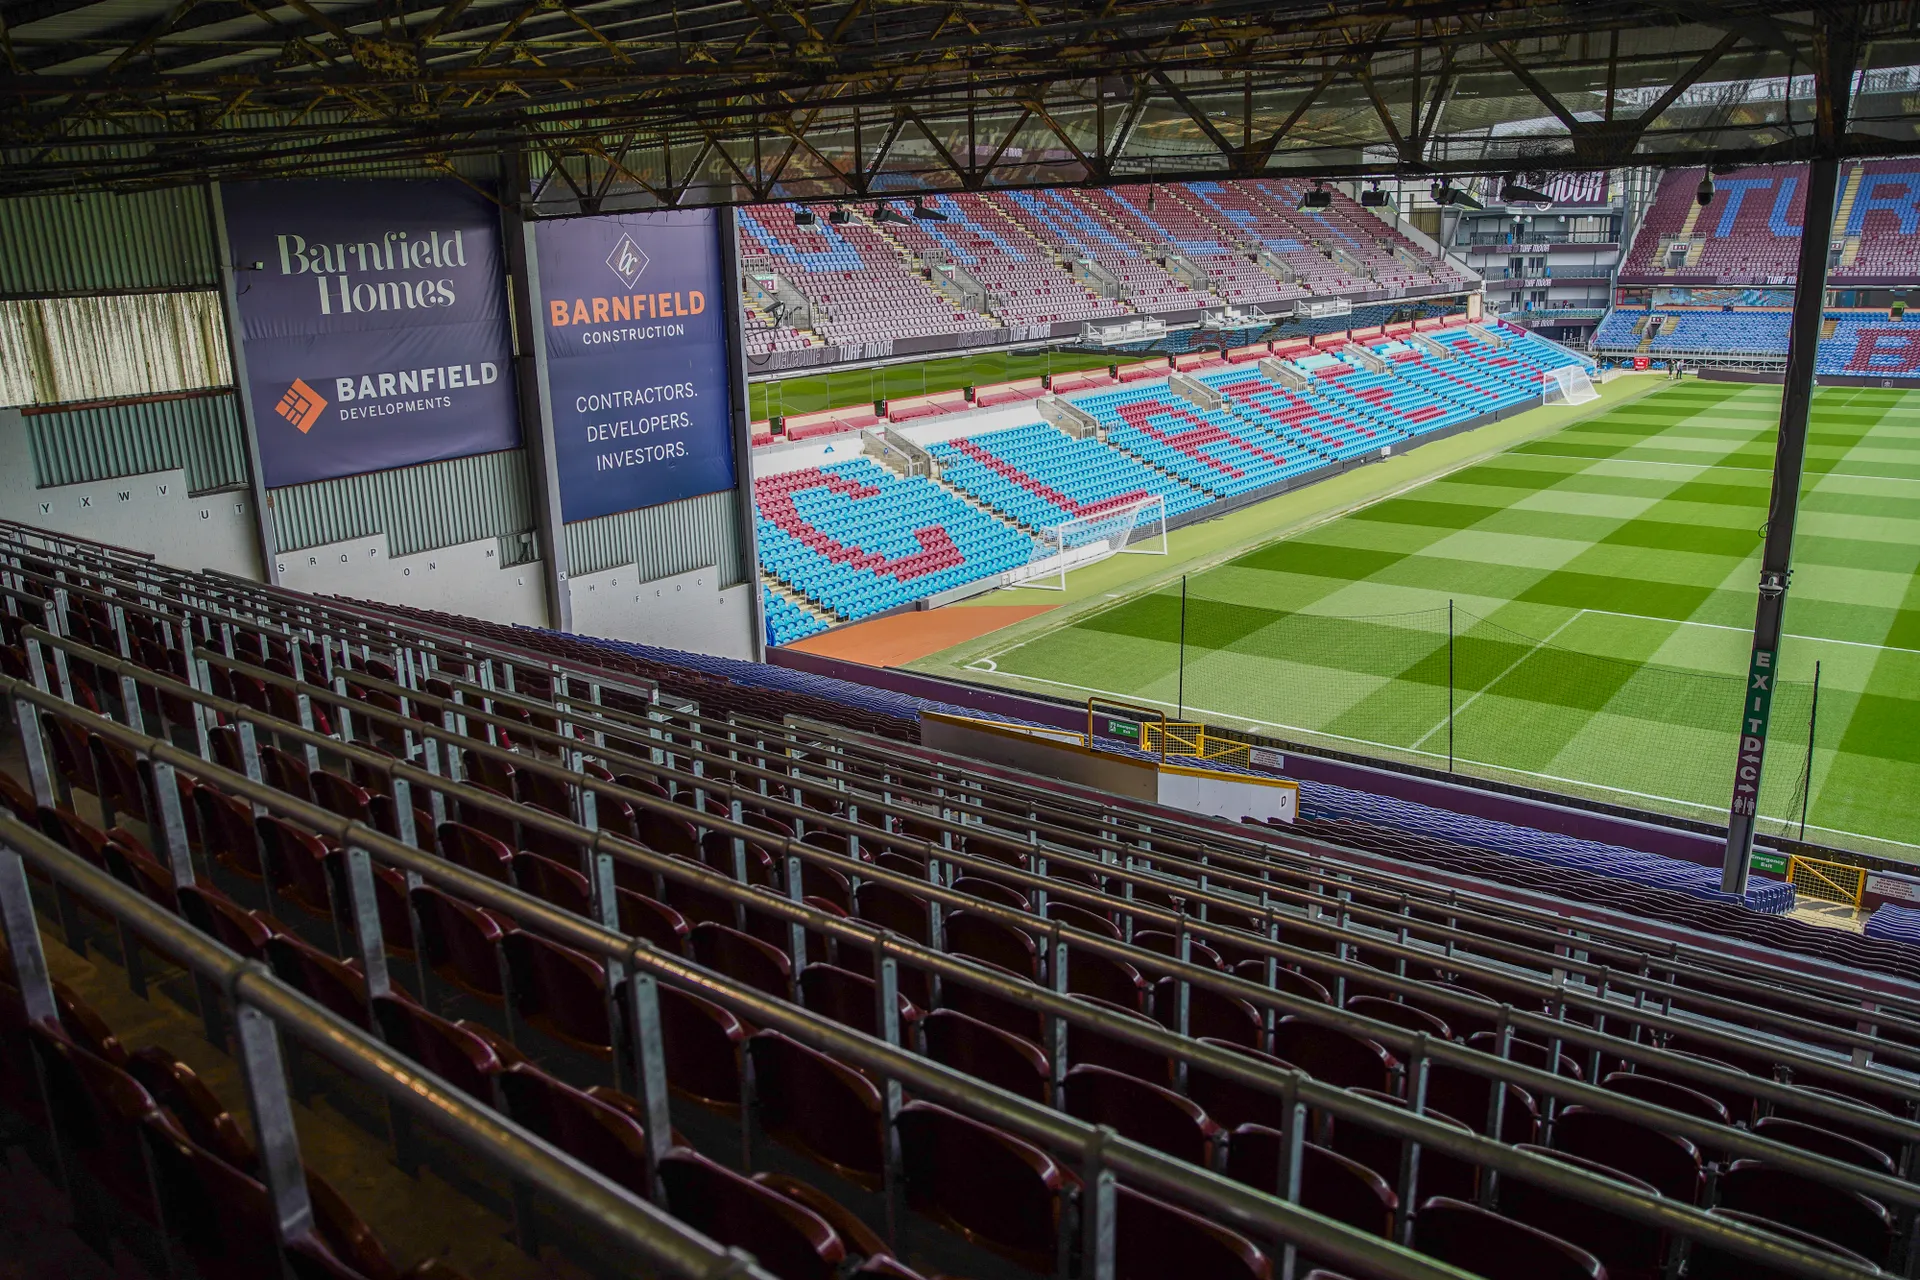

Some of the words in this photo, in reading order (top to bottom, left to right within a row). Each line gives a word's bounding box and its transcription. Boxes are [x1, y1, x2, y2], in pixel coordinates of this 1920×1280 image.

[276, 229, 467, 275] Barnfield
[317, 276, 456, 315] Homes
[550, 290, 706, 327] BARNFIELD
[582, 323, 685, 345] CONSTRUCTION
[1010, 326, 1028, 341] TURF
[1029, 323, 1051, 339] MOOR
[839, 341, 862, 362] TURF
[864, 339, 893, 358] MOOR
[336, 362, 498, 402] BARNFIELD
[576, 382, 699, 414] CONTRACTORS.
[339, 396, 452, 421] DEVELOPMENTS
[586, 412, 694, 443] DEVELOPERS.
[596, 441, 689, 471] INVESTORS.
[118, 491, 130, 501] W
[158, 486, 167, 495] V
[41, 504, 50, 514] Y
[82, 498, 91, 507] X
[235, 504, 243, 513] T
[201, 510, 209, 520] U
[309, 557, 317, 565] R
[340, 554, 348, 562] Q
[429, 562, 436, 570] N
[278, 564, 285, 572] S
[404, 568, 411, 576] O
[1748, 651, 1771, 733] EXIT
[1743, 736, 1761, 752] D
[1740, 765, 1756, 781] C
[1752, 854, 1785, 866] Emergency
